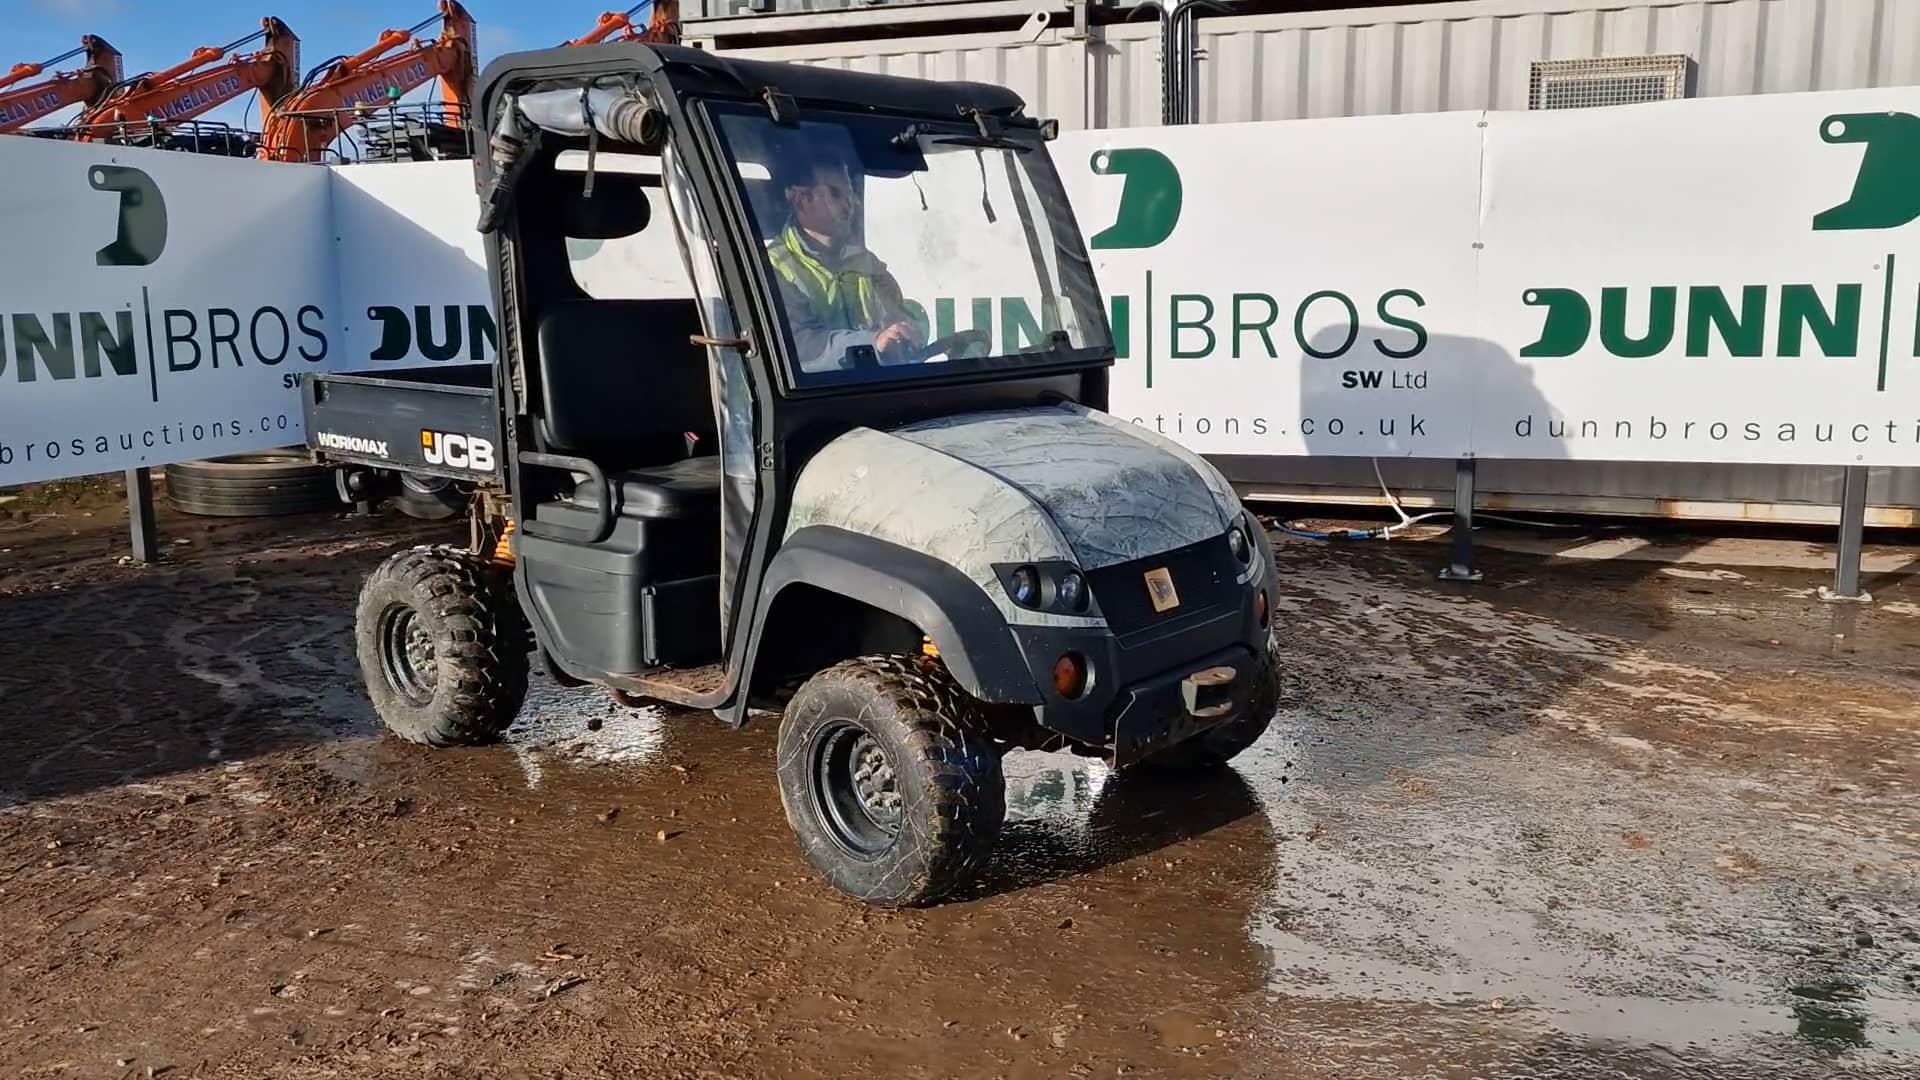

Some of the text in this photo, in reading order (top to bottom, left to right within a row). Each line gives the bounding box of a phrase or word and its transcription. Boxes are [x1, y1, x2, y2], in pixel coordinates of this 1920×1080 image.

[214, 76, 240, 98] LTD
[404, 60, 428, 85] LTD
[1170, 288, 1428, 360] BROS
[1519, 283, 1863, 359] DUNN
[0, 304, 328, 383] NN BROS
[1342, 369, 1428, 390] SW Ltd
[317, 431, 390, 457] WORKMAX
[420, 429, 496, 472] JCB
